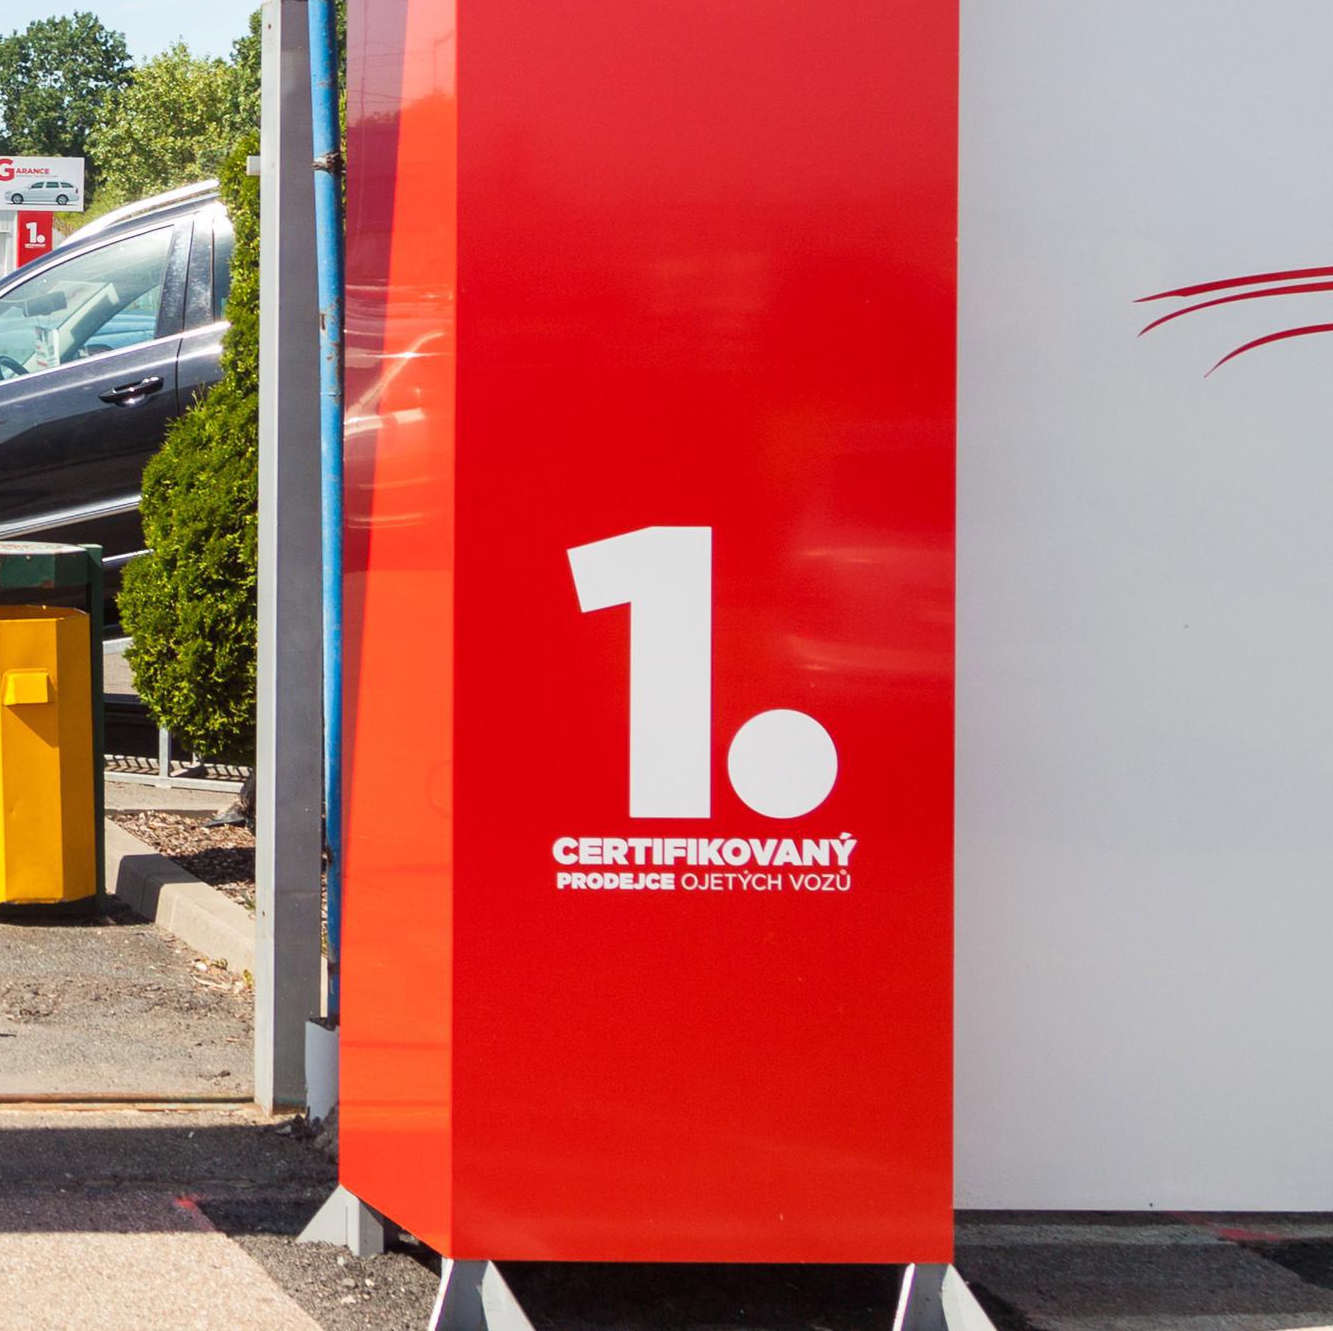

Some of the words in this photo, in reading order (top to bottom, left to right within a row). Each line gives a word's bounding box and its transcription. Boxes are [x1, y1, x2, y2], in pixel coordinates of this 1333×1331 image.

[566, 525, 838, 819] 1.
[552, 832, 857, 866] CERTIFIKOVANÝ
[556, 872, 675, 890] PRODEJCE
[681, 869, 782, 891] OJETÝCH
[790, 869, 851, 891] VOZŮ
